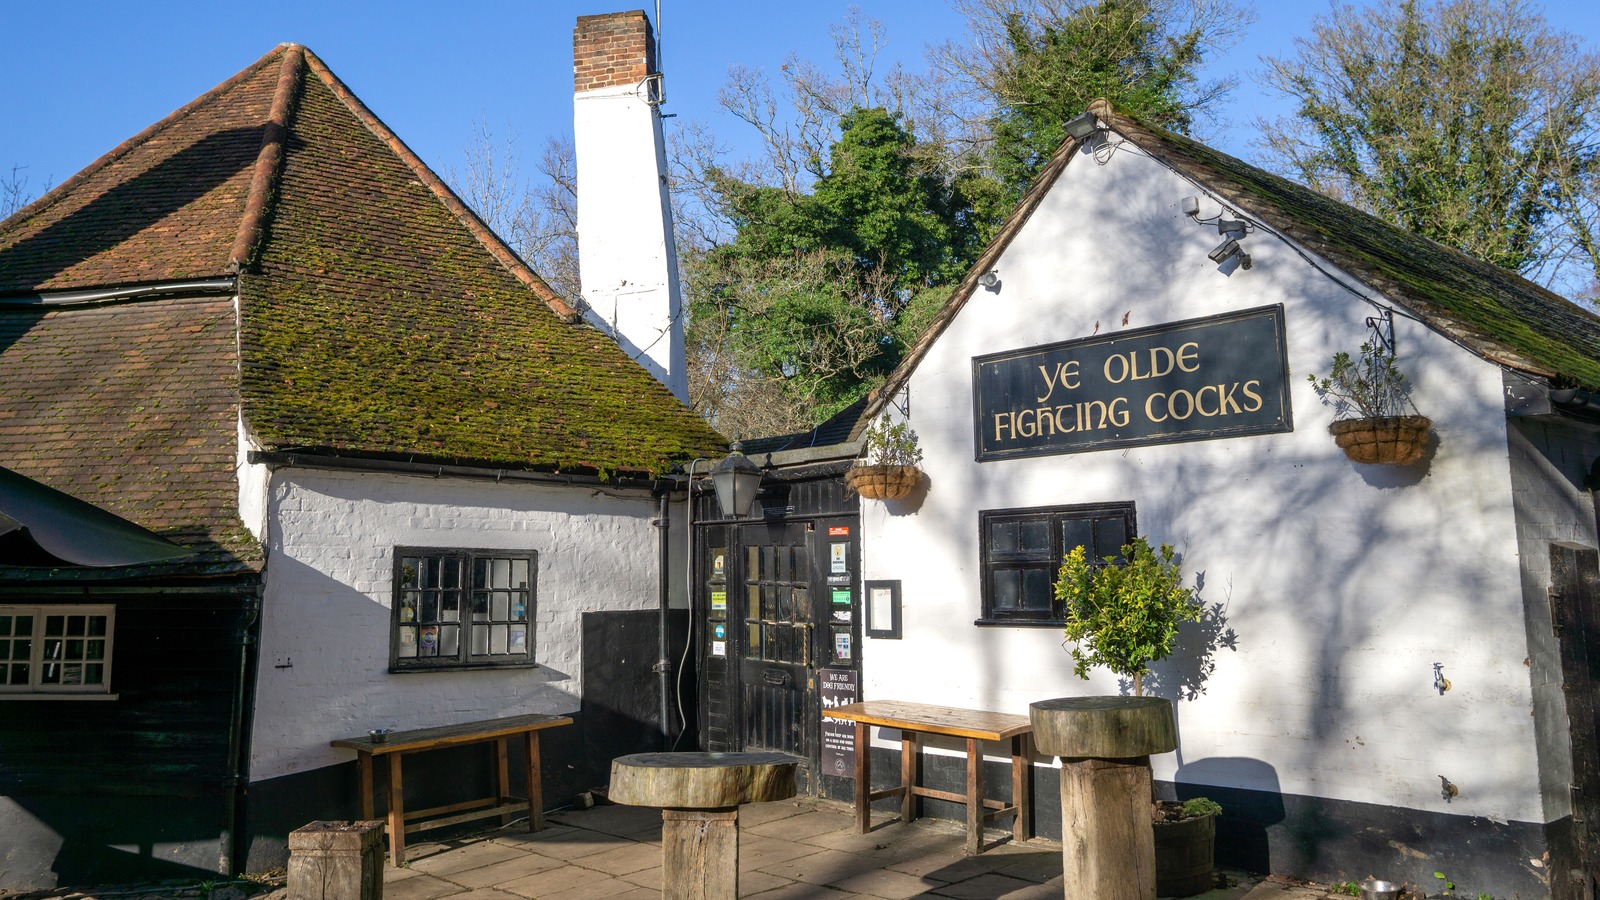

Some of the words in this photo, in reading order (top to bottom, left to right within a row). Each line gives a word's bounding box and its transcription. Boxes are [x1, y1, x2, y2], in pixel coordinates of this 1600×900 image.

[1037, 360, 1081, 403] YE
[1103, 341, 1201, 384] OLDE
[994, 397, 1130, 442] FIGHTING
[1144, 380, 1264, 423] COCKS
[822, 682, 833, 690] DOG
